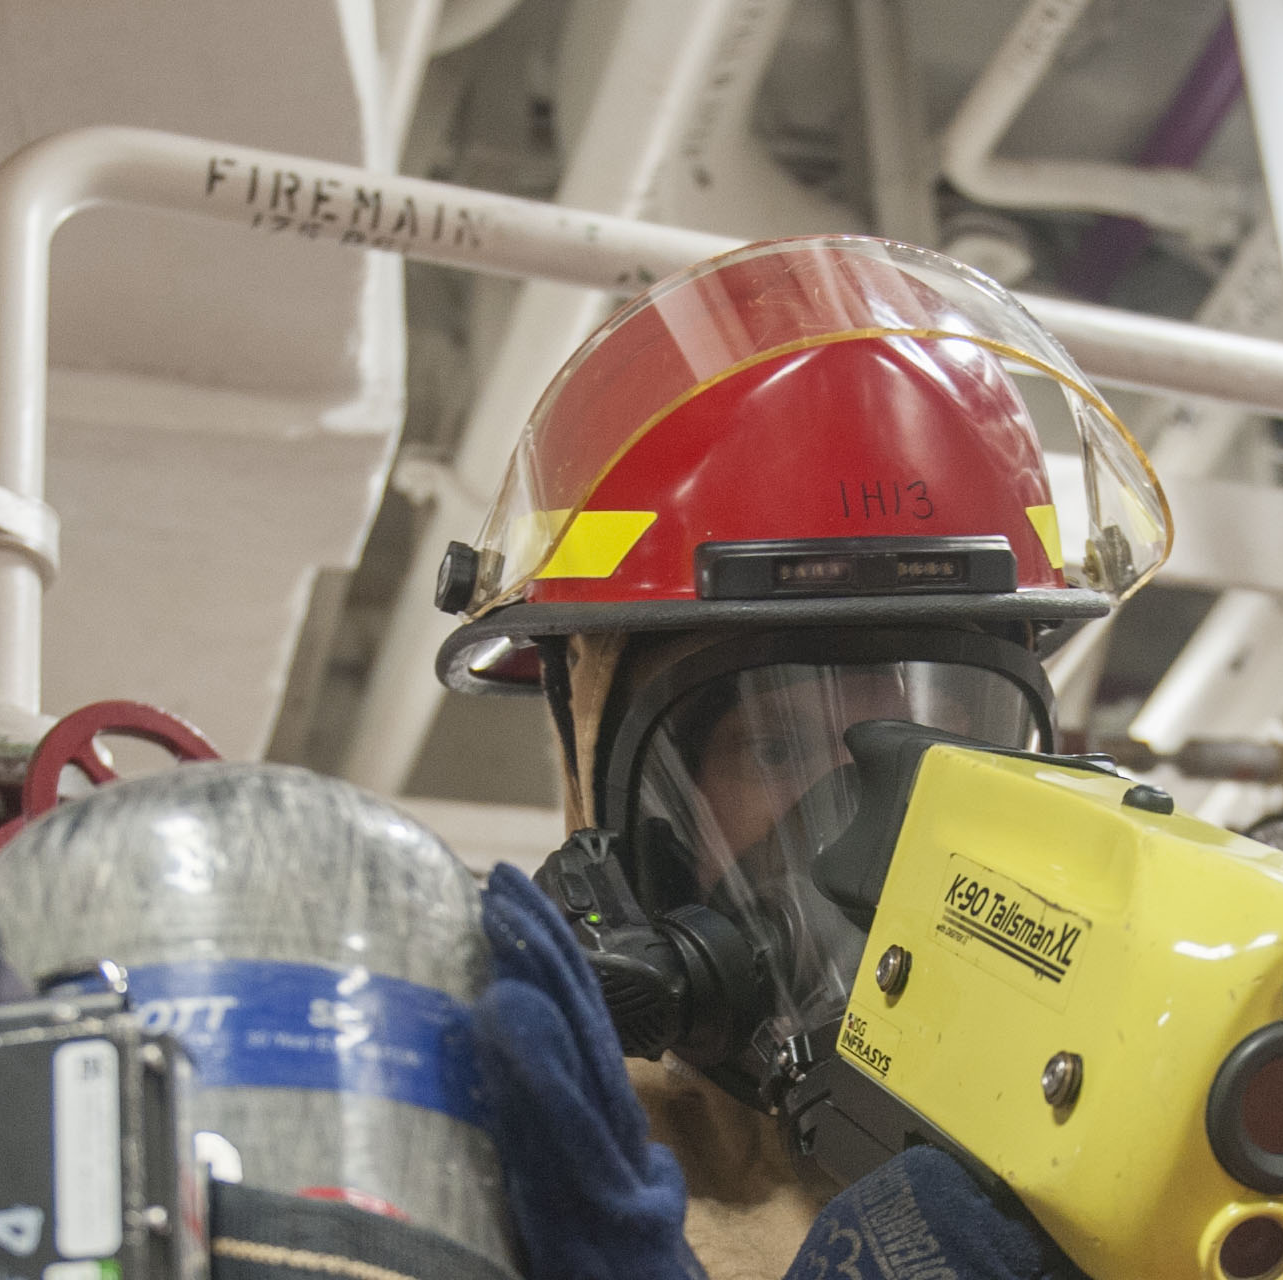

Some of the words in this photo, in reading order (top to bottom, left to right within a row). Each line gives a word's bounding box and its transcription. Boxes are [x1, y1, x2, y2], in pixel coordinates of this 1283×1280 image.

[205, 157, 484, 249] FIREMAIN
[944, 873, 989, 918] K-90
[985, 892, 1055, 956] Talisman
[1048, 922, 1082, 967] XL
[840, 1029, 892, 1072] INFRASYS
